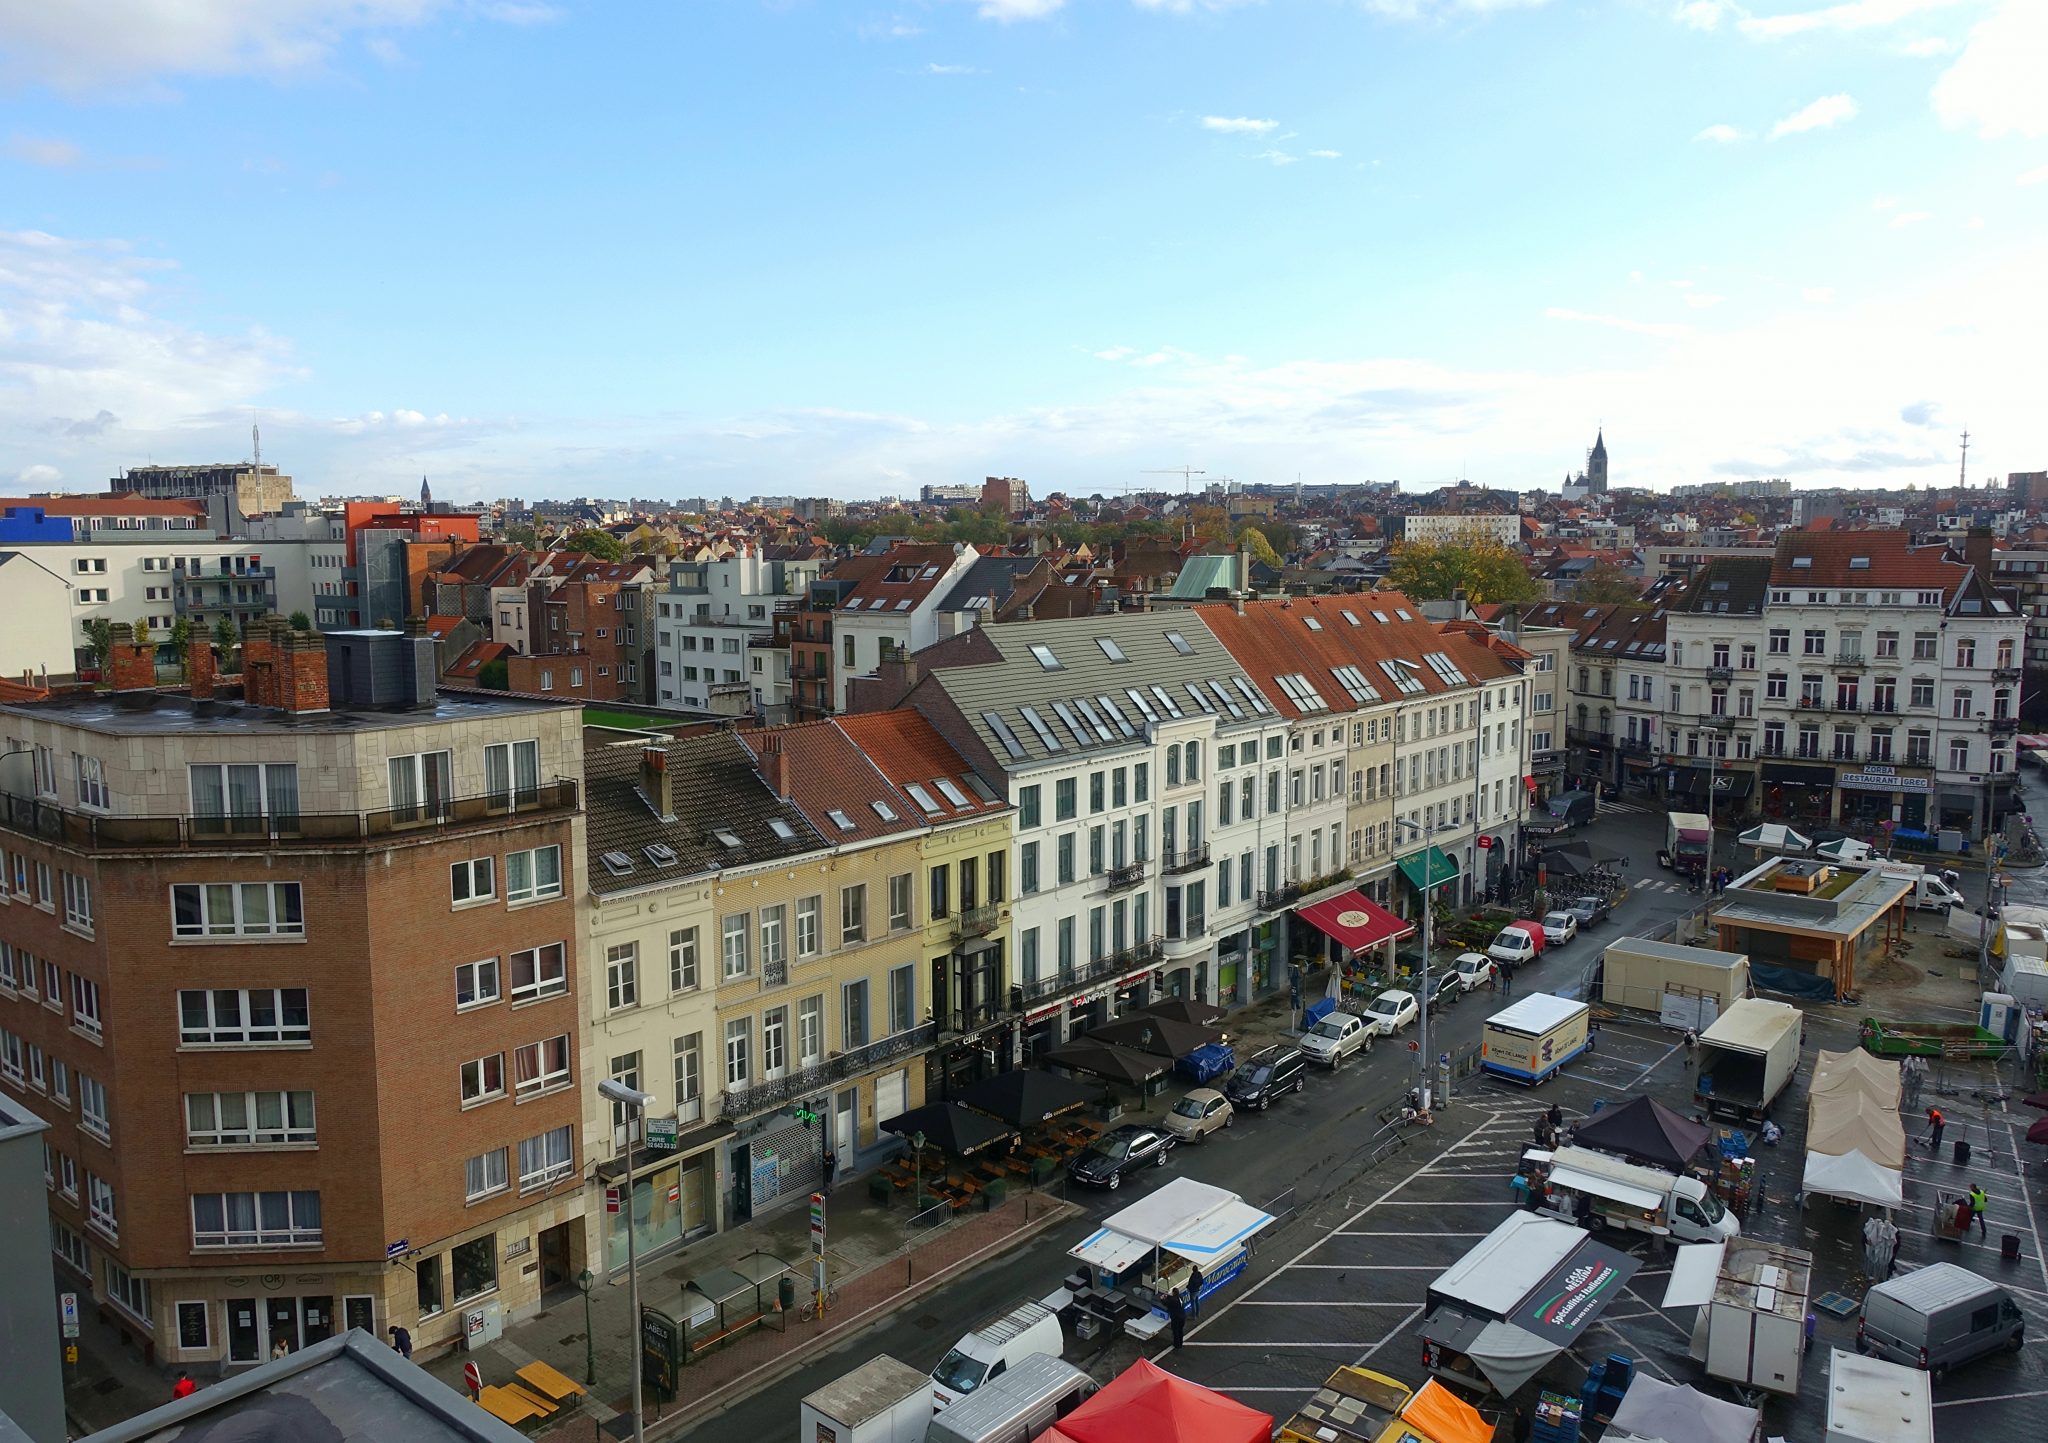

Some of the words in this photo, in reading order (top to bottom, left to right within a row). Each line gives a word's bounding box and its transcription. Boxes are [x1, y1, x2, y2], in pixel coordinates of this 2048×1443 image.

[1865, 766, 1893, 774] ZORBA
[1843, 774, 1898, 785] RESTAURANT
[1903, 778, 1926, 787] GREC
[1076, 988, 1110, 1008] PAMPAS
[264, 1274, 281, 1283] OR
[1565, 1268, 1584, 1284] CASA
[1565, 1265, 1594, 1292] MESSINA
[1551, 1294, 1586, 1325] Spécialités
[1580, 1266, 1613, 1296] Italiennes
